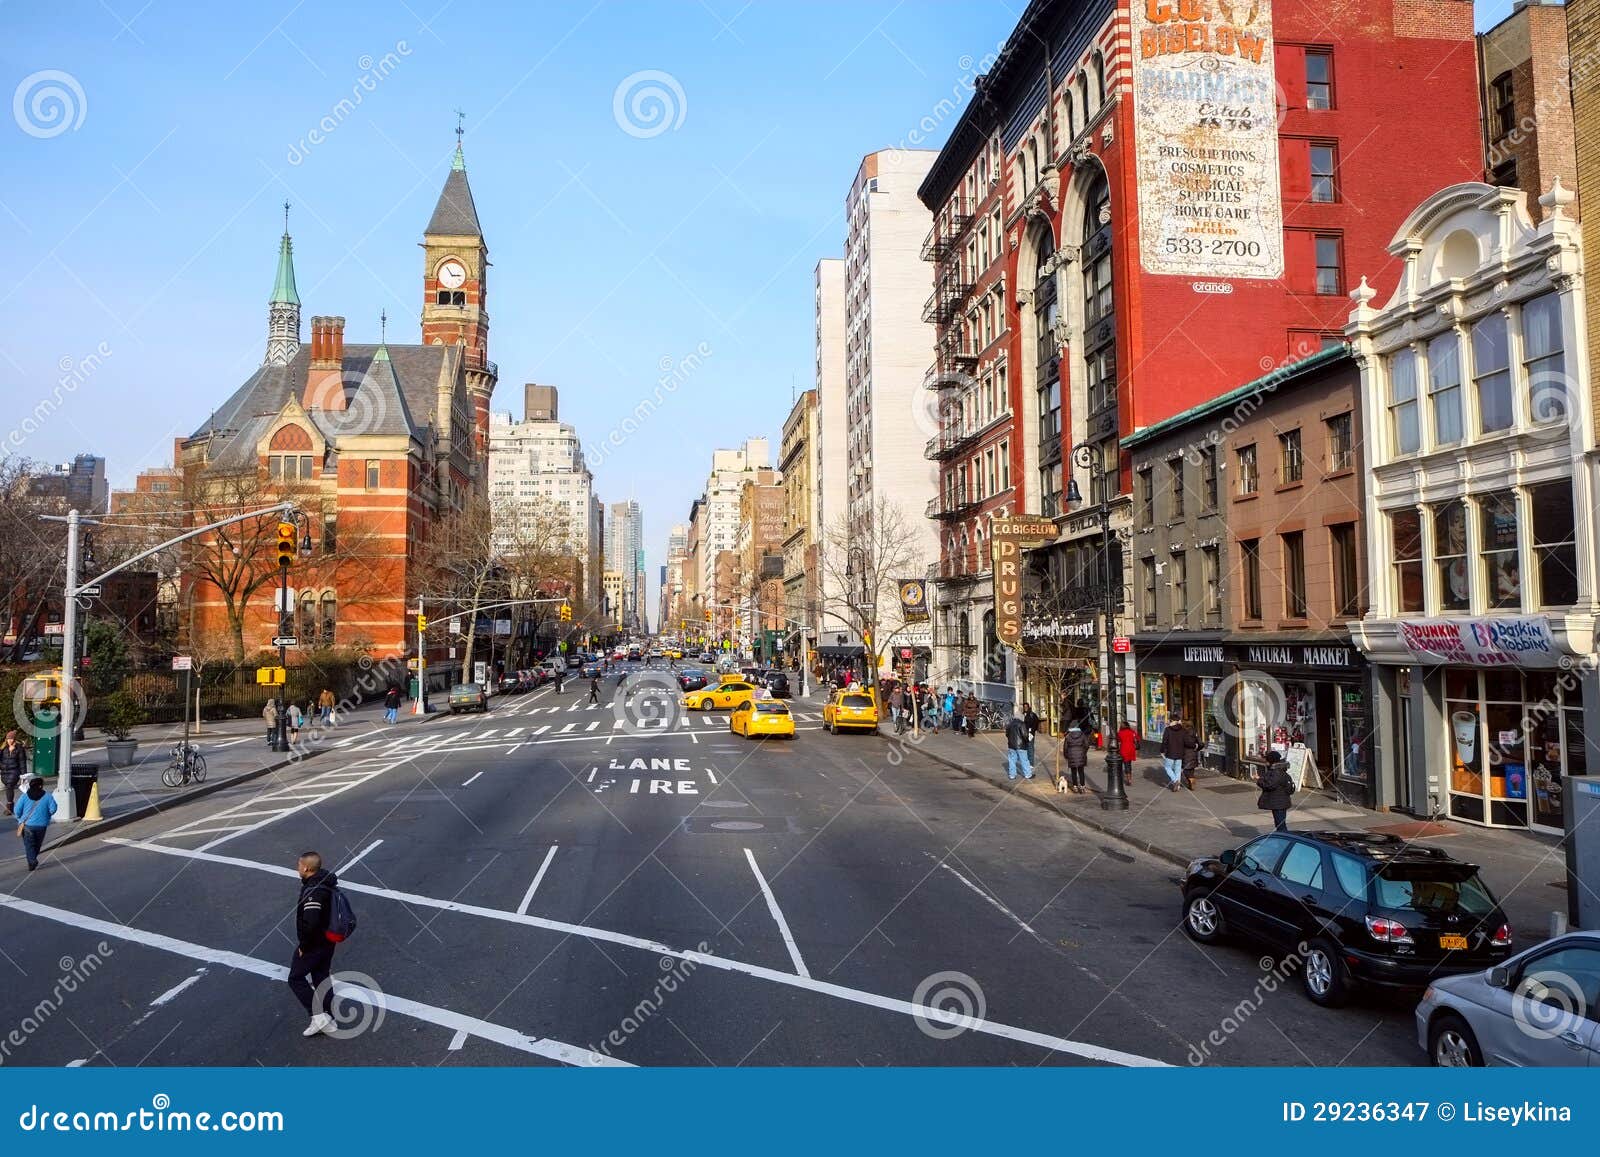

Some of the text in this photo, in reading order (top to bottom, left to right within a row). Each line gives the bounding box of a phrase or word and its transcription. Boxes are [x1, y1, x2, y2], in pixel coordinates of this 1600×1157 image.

[1140, 23, 1268, 64] BIGELOW
[1142, 68, 1268, 104] PHARMACY
[1159, 146, 1256, 161] PRESCRIPTIONS
[1171, 162, 1245, 176] COSMETICS
[1179, 190, 1241, 203] SUPPLIES
[1175, 205, 1251, 220] HOME CARE
[1166, 238, 1261, 257] 533-2700
[1194, 282, 1233, 293] orange
[1013, 524, 1057, 535] BIGELOW
[1001, 541, 1018, 636] DRUGS
[1414, 623, 1461, 638] DUNKIN'
[1421, 638, 1465, 652] DONUTS
[1184, 647, 1351, 666] LIFETHYME NATURAL MARKET
[609, 758, 692, 771] LANE
